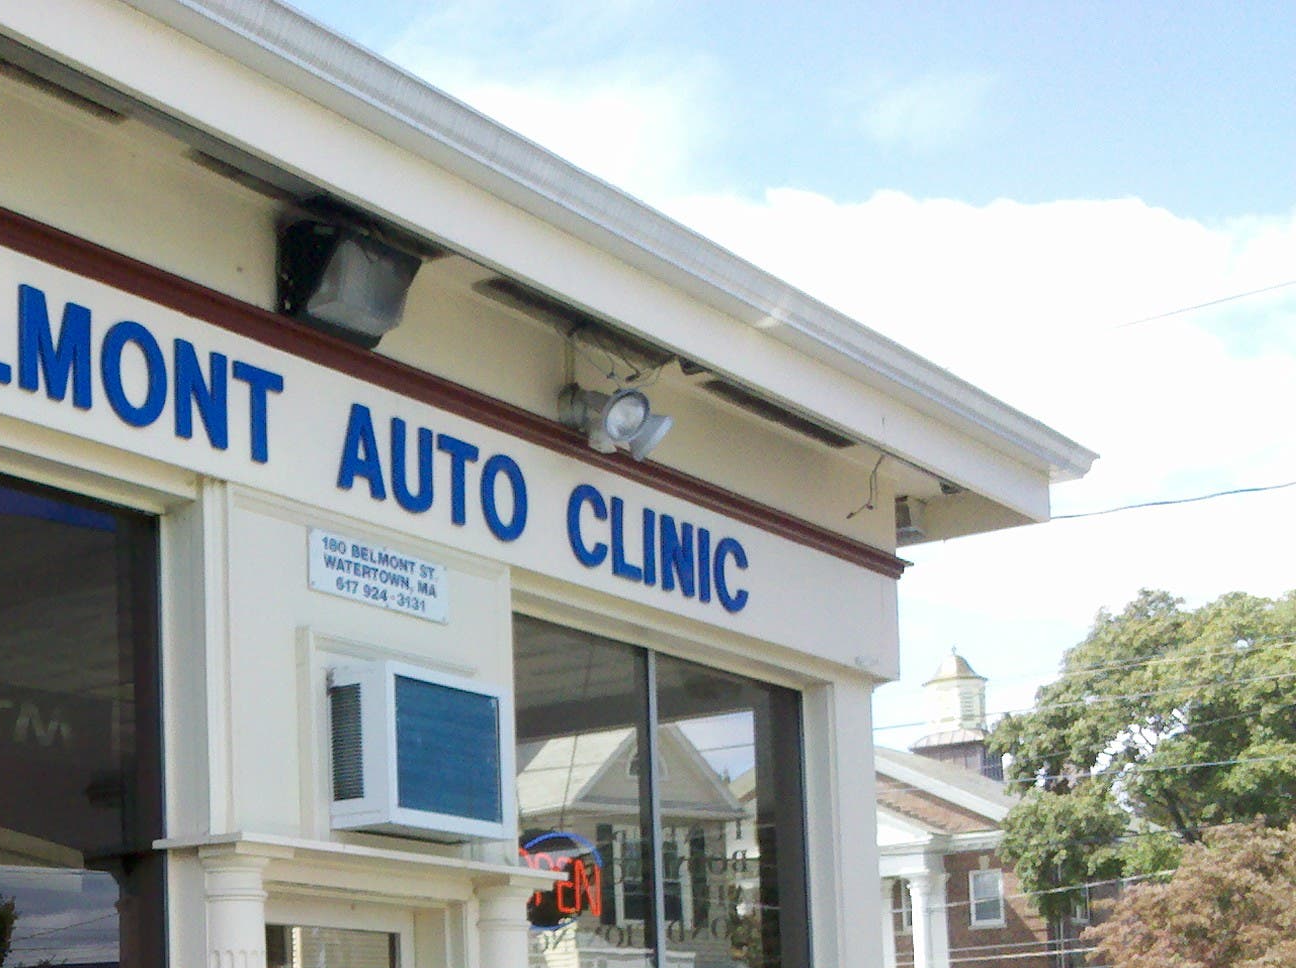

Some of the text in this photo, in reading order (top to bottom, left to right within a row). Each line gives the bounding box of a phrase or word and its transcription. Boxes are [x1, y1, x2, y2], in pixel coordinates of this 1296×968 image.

[337, 403, 528, 542] AUTO
[567, 485, 749, 613] CLINIC
[321, 536, 347, 556] 180
[350, 544, 416, 575] BELMONT
[336, 577, 359, 594] 617
[417, 579, 438, 599] MA
[519, 850, 603, 917] PEN
